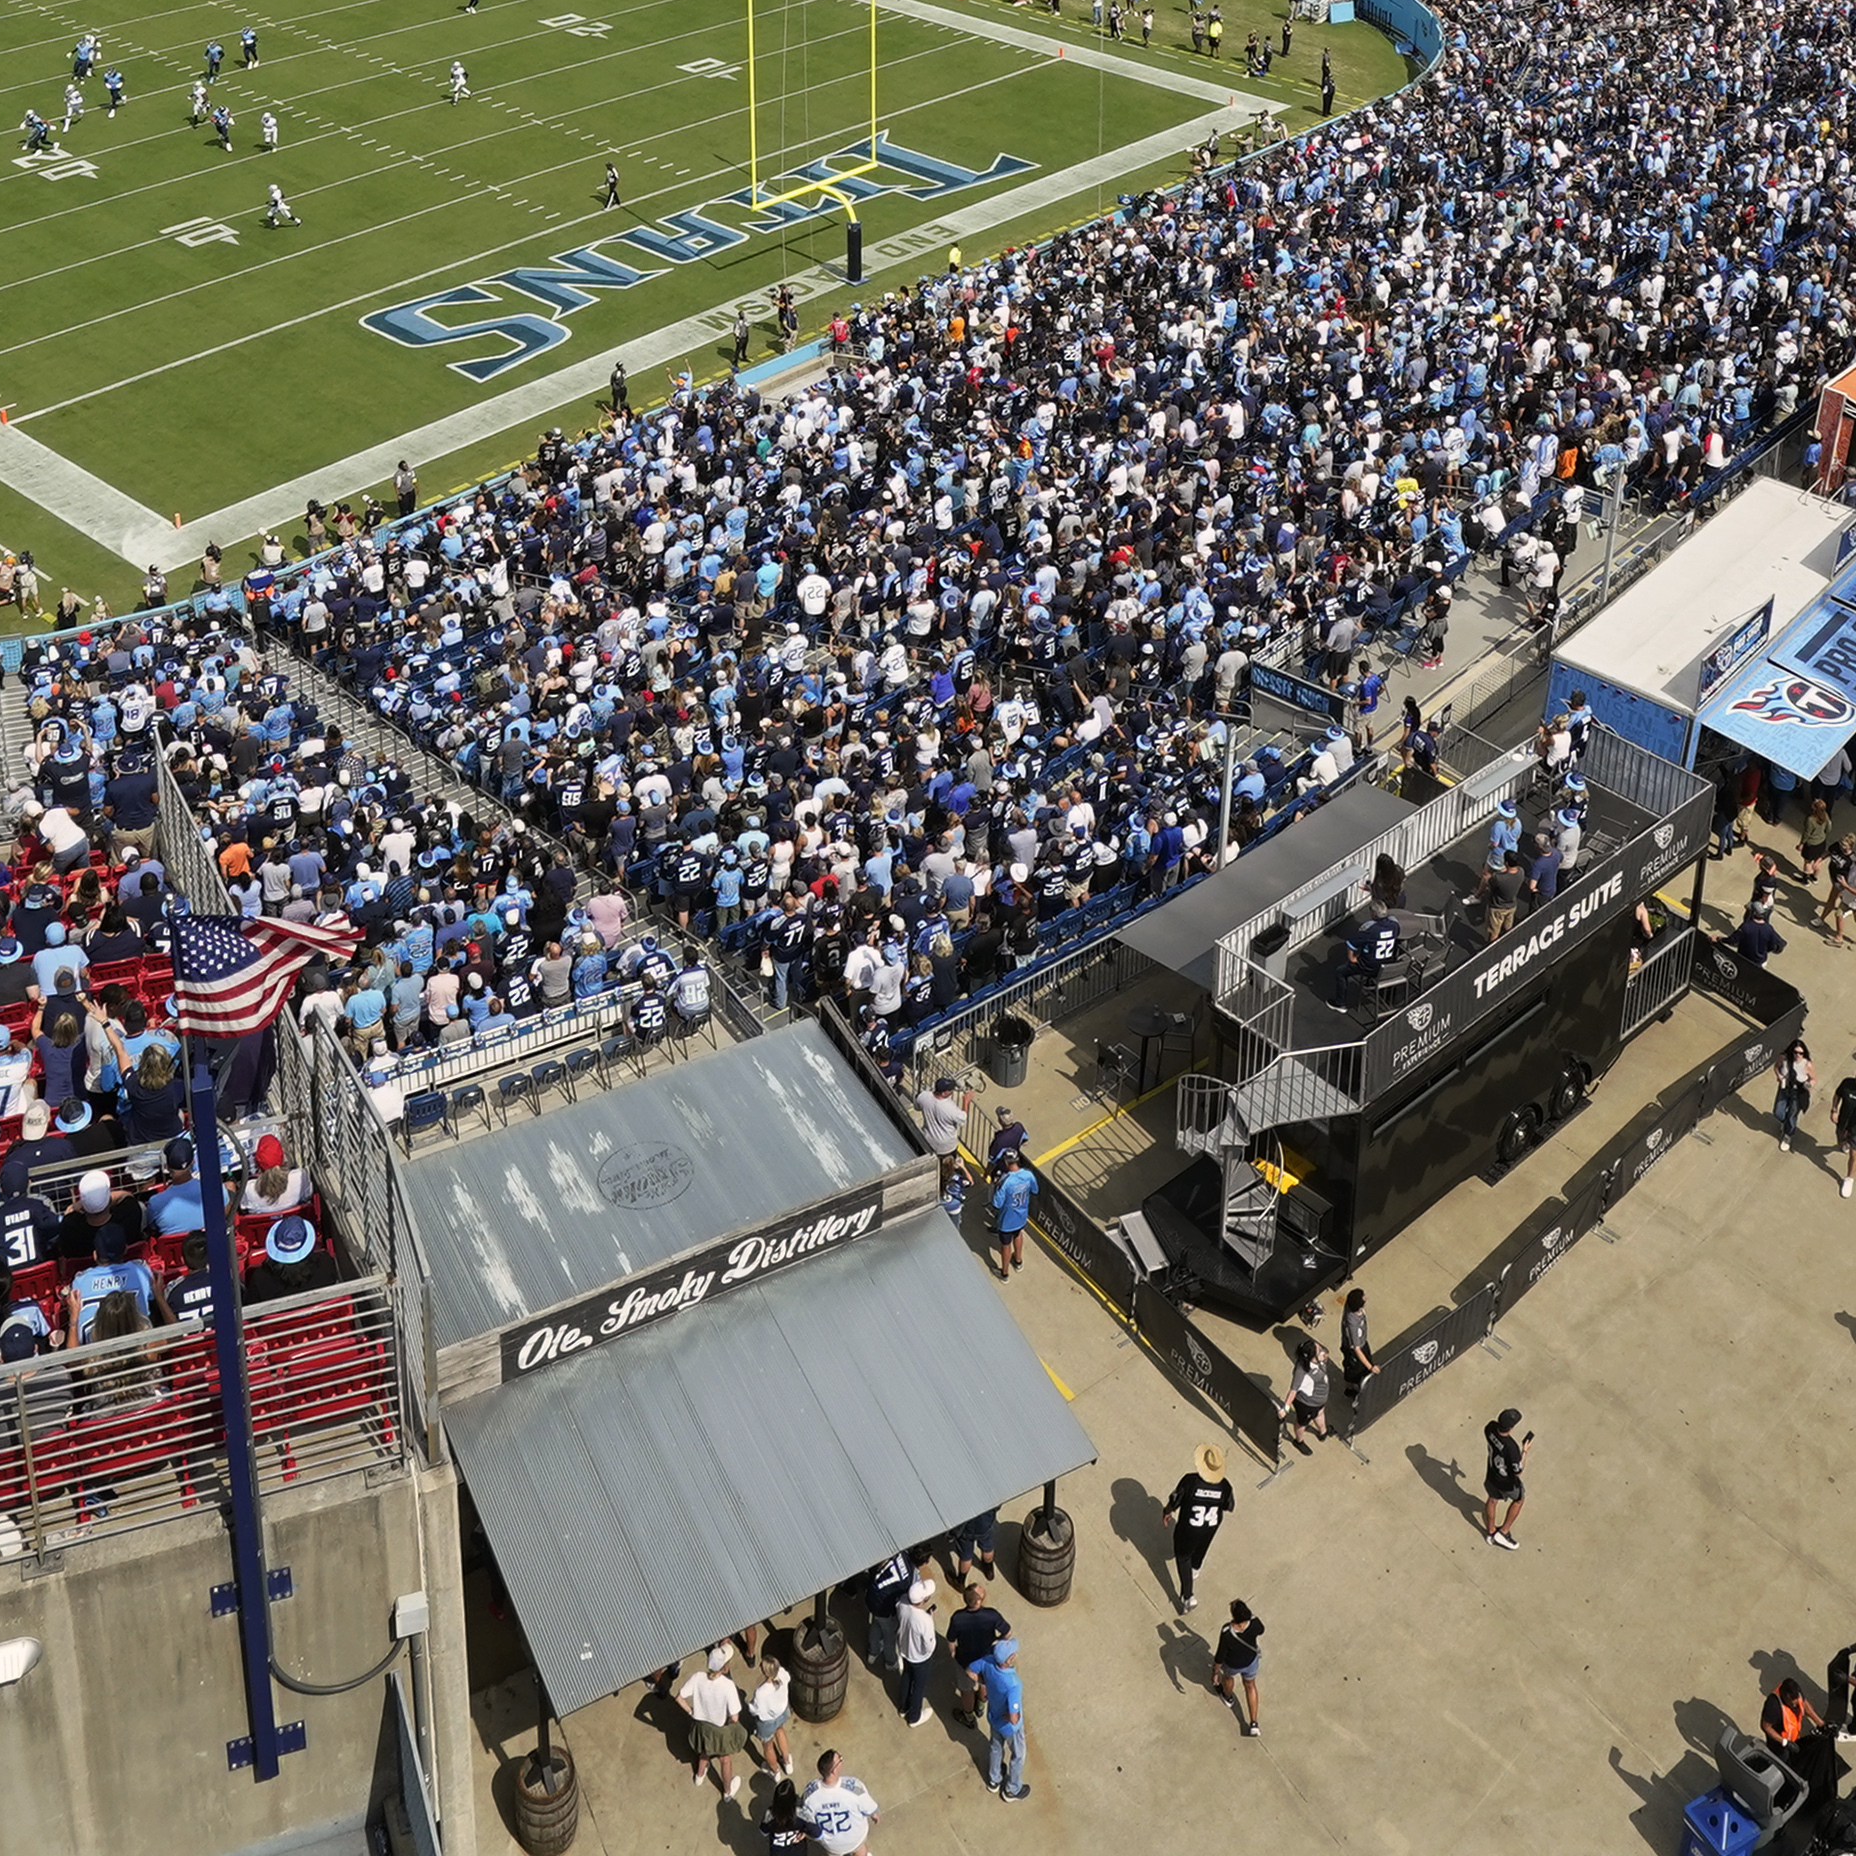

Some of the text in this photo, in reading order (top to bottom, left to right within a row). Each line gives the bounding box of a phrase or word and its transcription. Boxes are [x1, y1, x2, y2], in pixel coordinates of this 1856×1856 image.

[158, 215, 241, 248] 10
[356, 127, 1042, 384] TITANS
[1639, 835, 1690, 881] PREMIUM
[784, 924, 806, 947] 77
[1374, 936, 1395, 959] 22
[1473, 869, 1625, 1000] TERRACE SUITE
[1694, 961, 1758, 1009] PREMIUM
[638, 1005, 665, 1028] 22
[1391, 1012, 1452, 1068] PREMIUM
[4, 1224, 36, 1267] 31
[1037, 1209, 1092, 1270] PREMIUM
[92, 1274, 128, 1291] HENRY
[517, 1203, 879, 1370] Ole Smoky Distillery
[814, 1810, 852, 1835] 22
